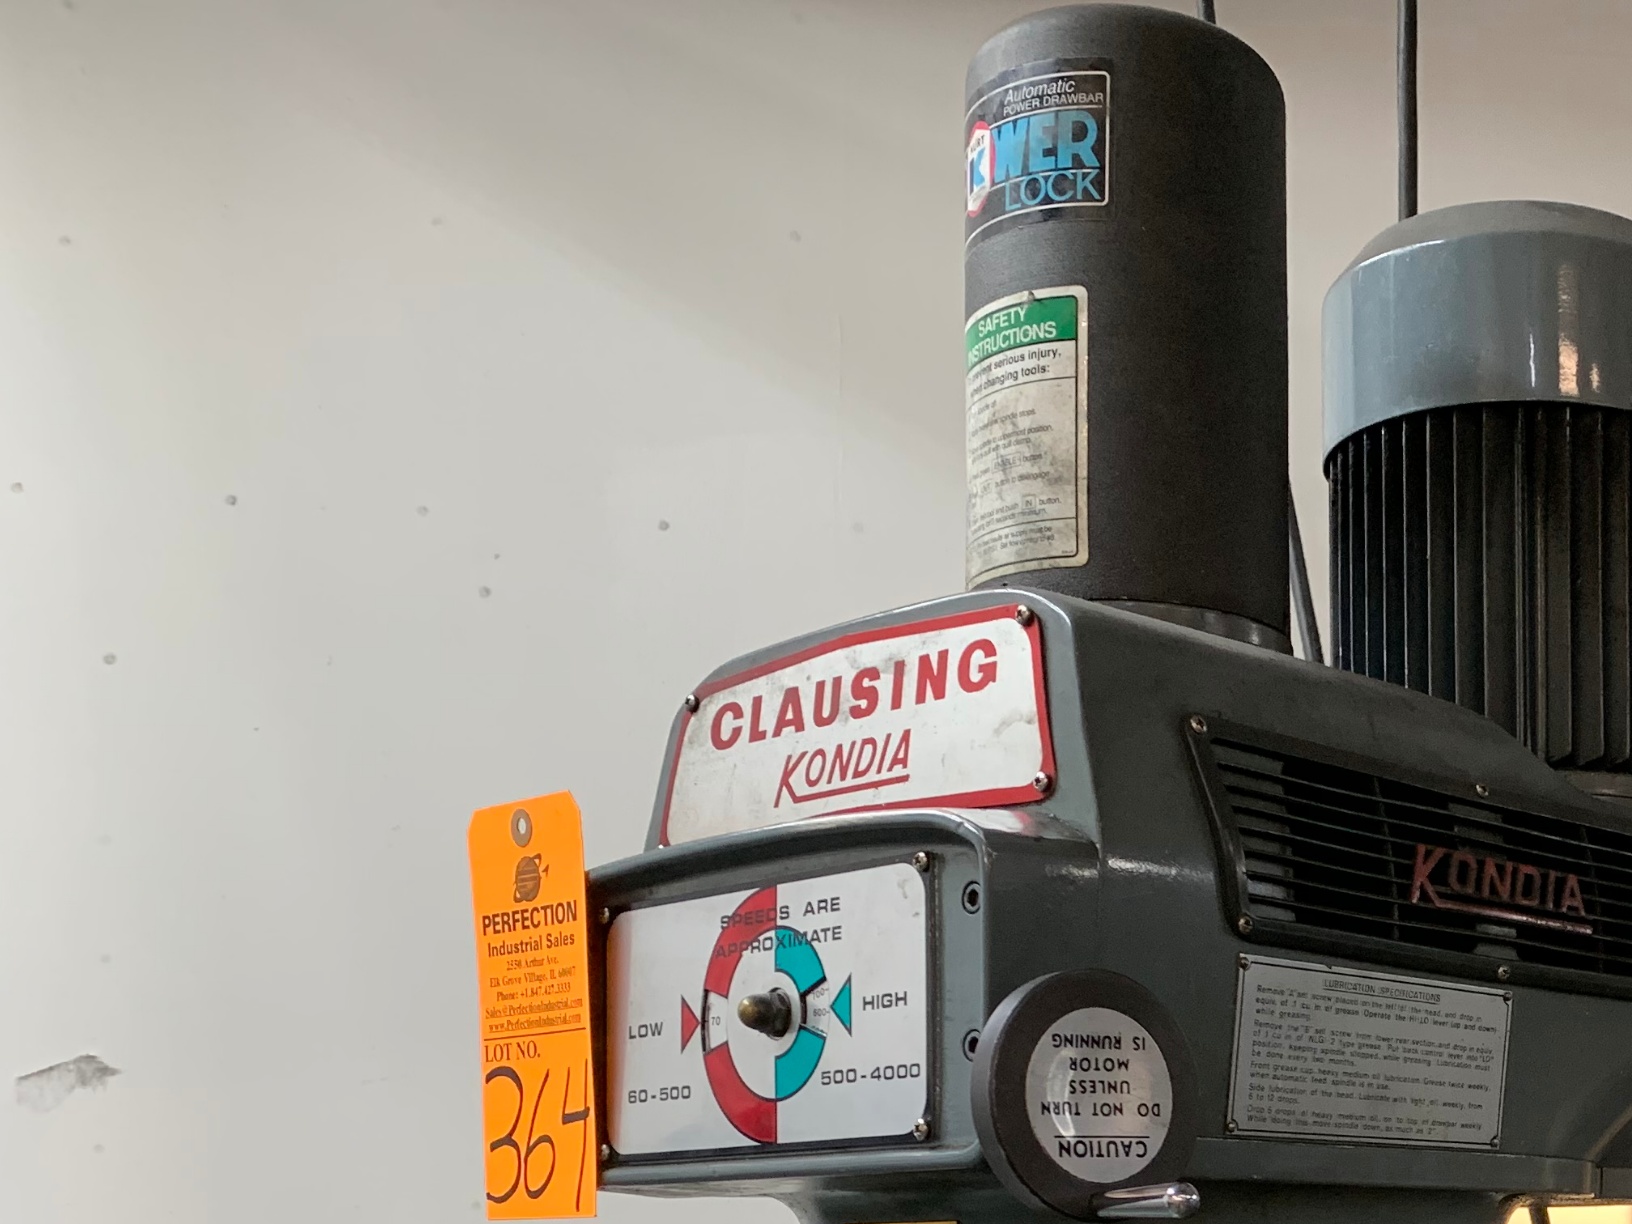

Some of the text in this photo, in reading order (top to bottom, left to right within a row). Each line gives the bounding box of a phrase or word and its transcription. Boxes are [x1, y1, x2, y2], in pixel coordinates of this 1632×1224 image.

[1004, 78, 1075, 105] Automatic
[1003, 93, 1104, 116] POWER DRAWBAR
[1004, 170, 1101, 211] LOCK
[978, 306, 1027, 337] SAFETY
[994, 348, 1061, 369] serious injury,
[984, 365, 1050, 389] changing tools:
[710, 638, 998, 751] CLAUSING
[773, 729, 912, 808] KONDIA
[1410, 844, 1591, 928] KONDIA
[482, 900, 577, 936] PERFECTION
[720, 896, 841, 930] SPEEDS ARE
[488, 931, 575, 958] Industrial Sales
[714, 925, 843, 959] APPROXIMATE
[502, 976, 521, 986] Grove
[1324, 980, 1441, 1002] LUBRICATION SPECIFICATIONS
[497, 991, 518, 1002] Phone:
[863, 991, 908, 1011] HIGH
[711, 1016, 721, 1026] 70
[1364, 1009, 1391, 1021] Operate
[628, 1022, 663, 1040] LOW
[1052, 1034, 1146, 1050] IS RUNNING
[485, 1040, 540, 1062] LOT NO.
[821, 1063, 921, 1086] 500-4000
[1070, 1058, 1129, 1071] MOTOR
[628, 1085, 691, 1104] 60-500
[1069, 1080, 1130, 1094] UNLESS
[1041, 1102, 1160, 1116] DO NOT TURN
[485, 1058, 590, 1212] 364
[1058, 1141, 1148, 1157] CAUTION
